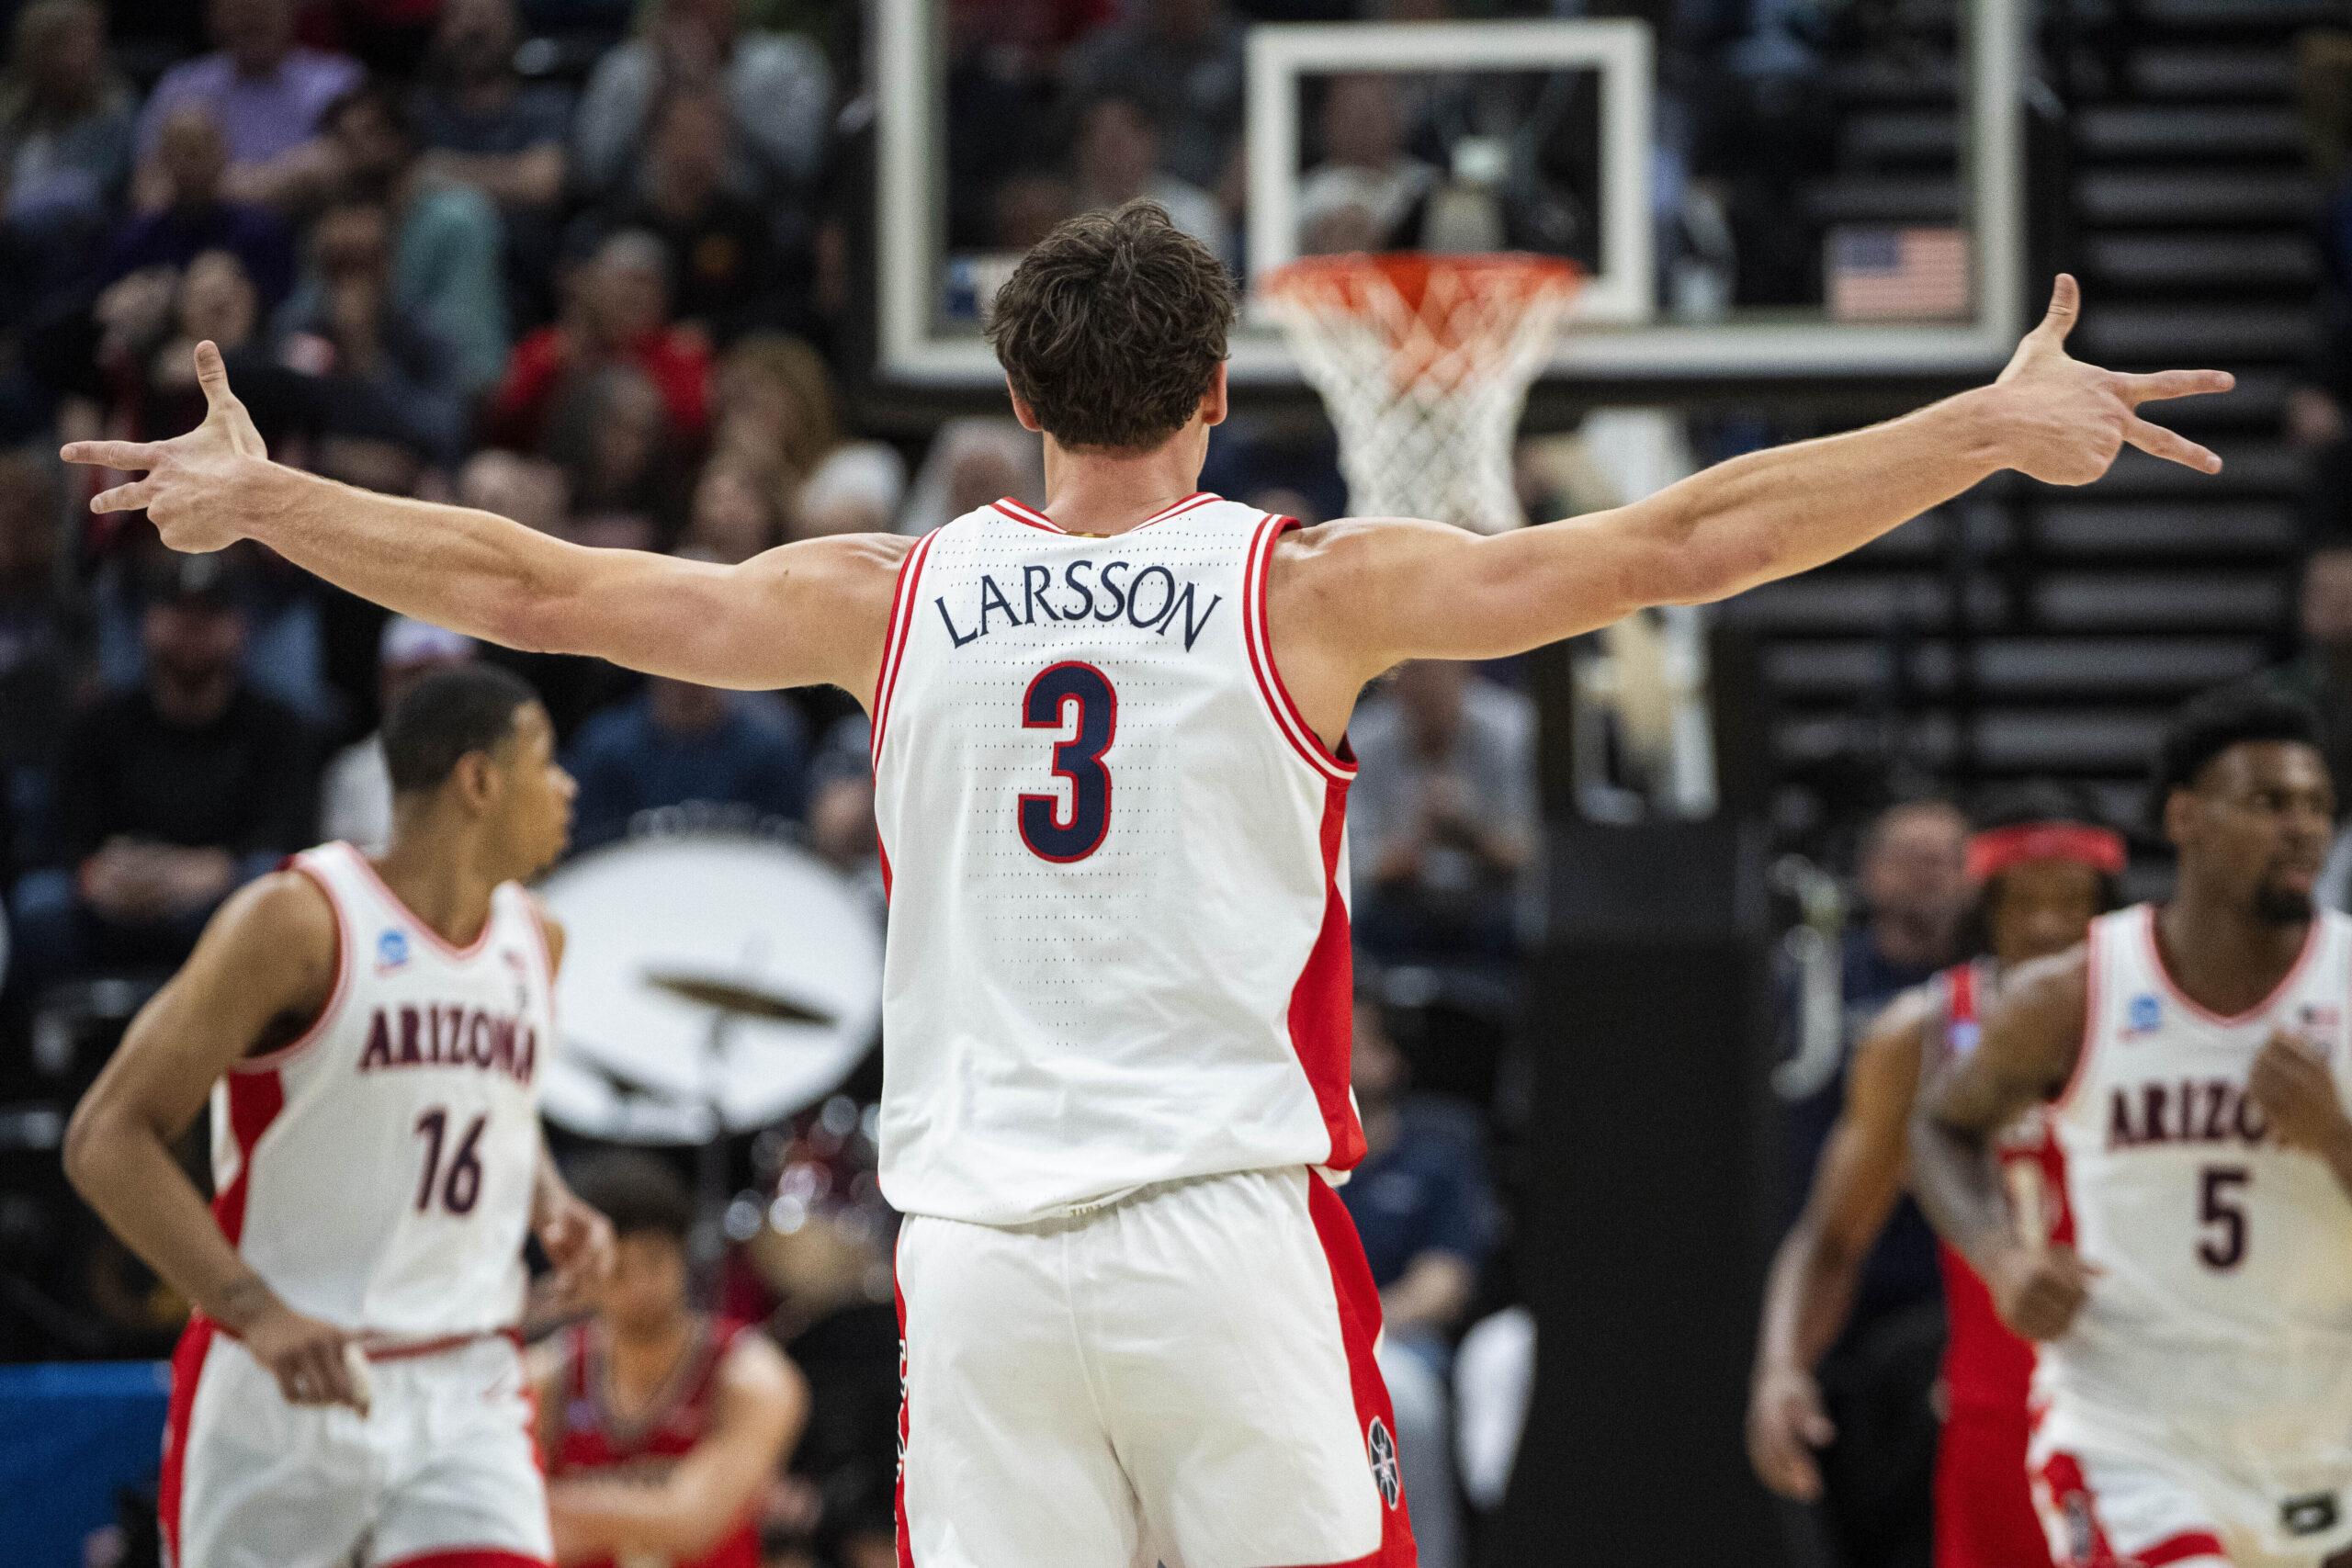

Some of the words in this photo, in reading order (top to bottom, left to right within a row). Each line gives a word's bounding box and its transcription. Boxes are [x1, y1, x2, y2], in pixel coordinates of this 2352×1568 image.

[934, 560, 1222, 652] LARSSON
[1018, 660, 1117, 864] 3
[359, 1004, 536, 1085] ARIZONA
[416, 1108, 487, 1215] 16
[2108, 1080, 2267, 1148] ARIZO
[2197, 1167, 2253, 1269] 5
